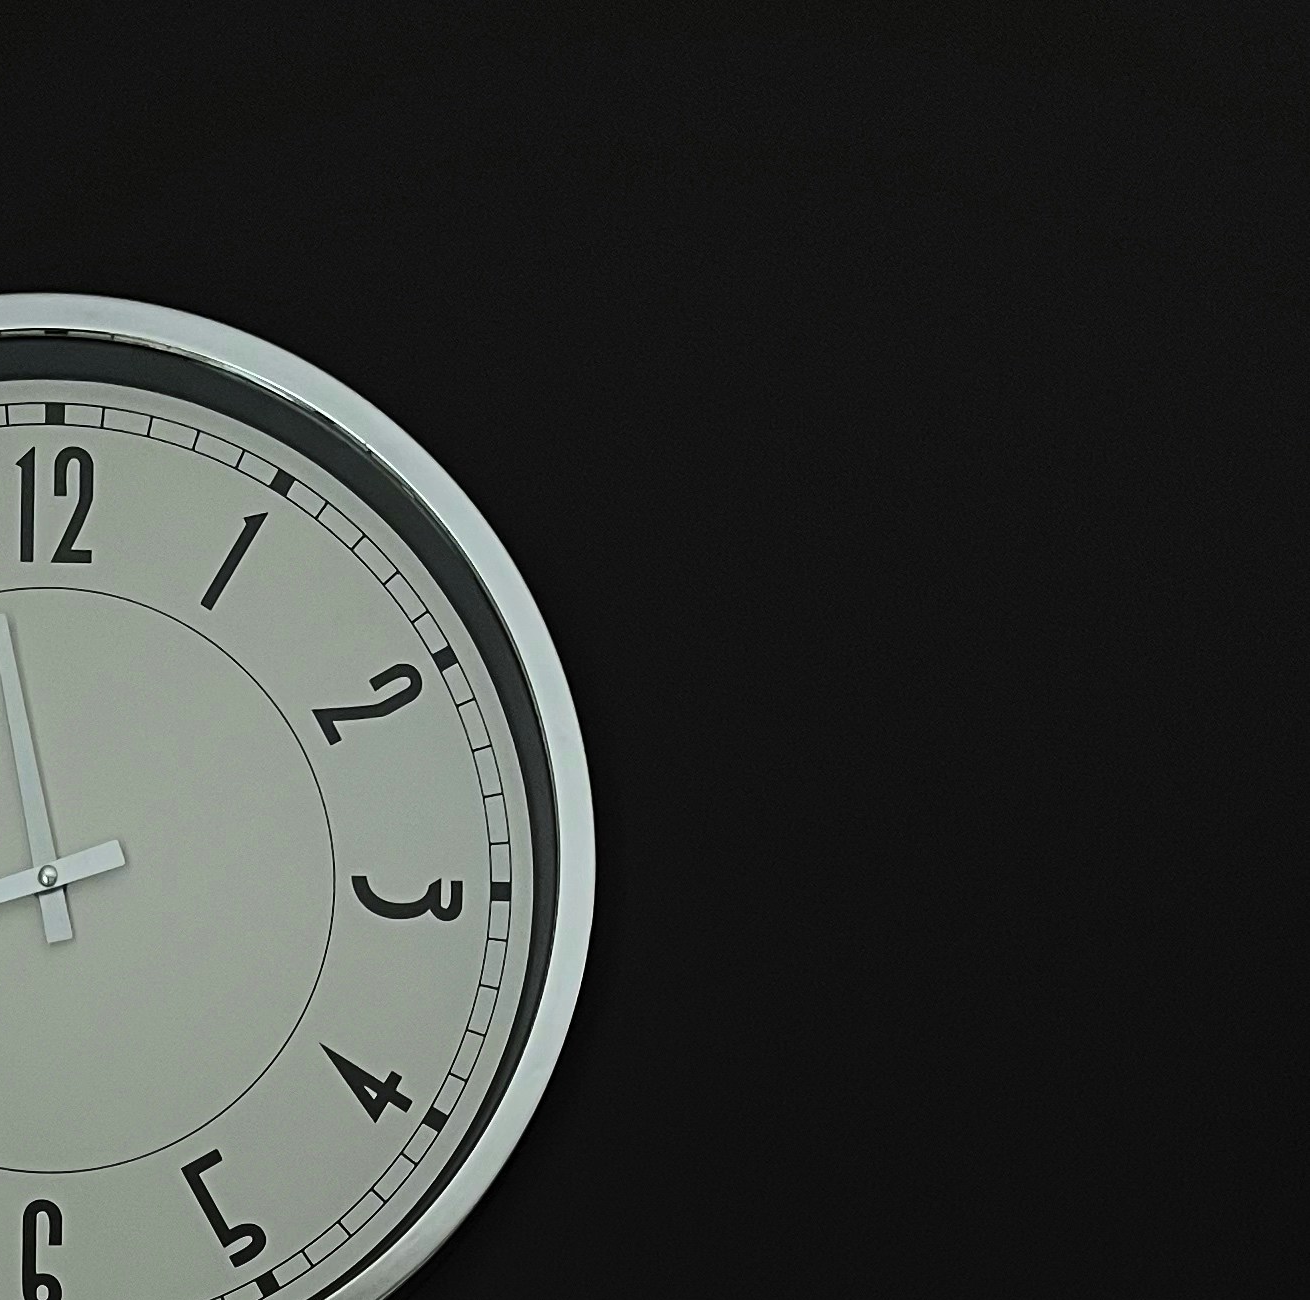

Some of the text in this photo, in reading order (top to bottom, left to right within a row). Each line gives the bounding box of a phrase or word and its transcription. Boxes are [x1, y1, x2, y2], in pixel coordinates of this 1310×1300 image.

[14, 445, 94, 564] 12
[200, 511, 269, 611] 1
[311, 663, 423, 746] 2
[350, 875, 464, 922] 3
[318, 1042, 413, 1124] 4
[180, 1148, 267, 1269] 5
